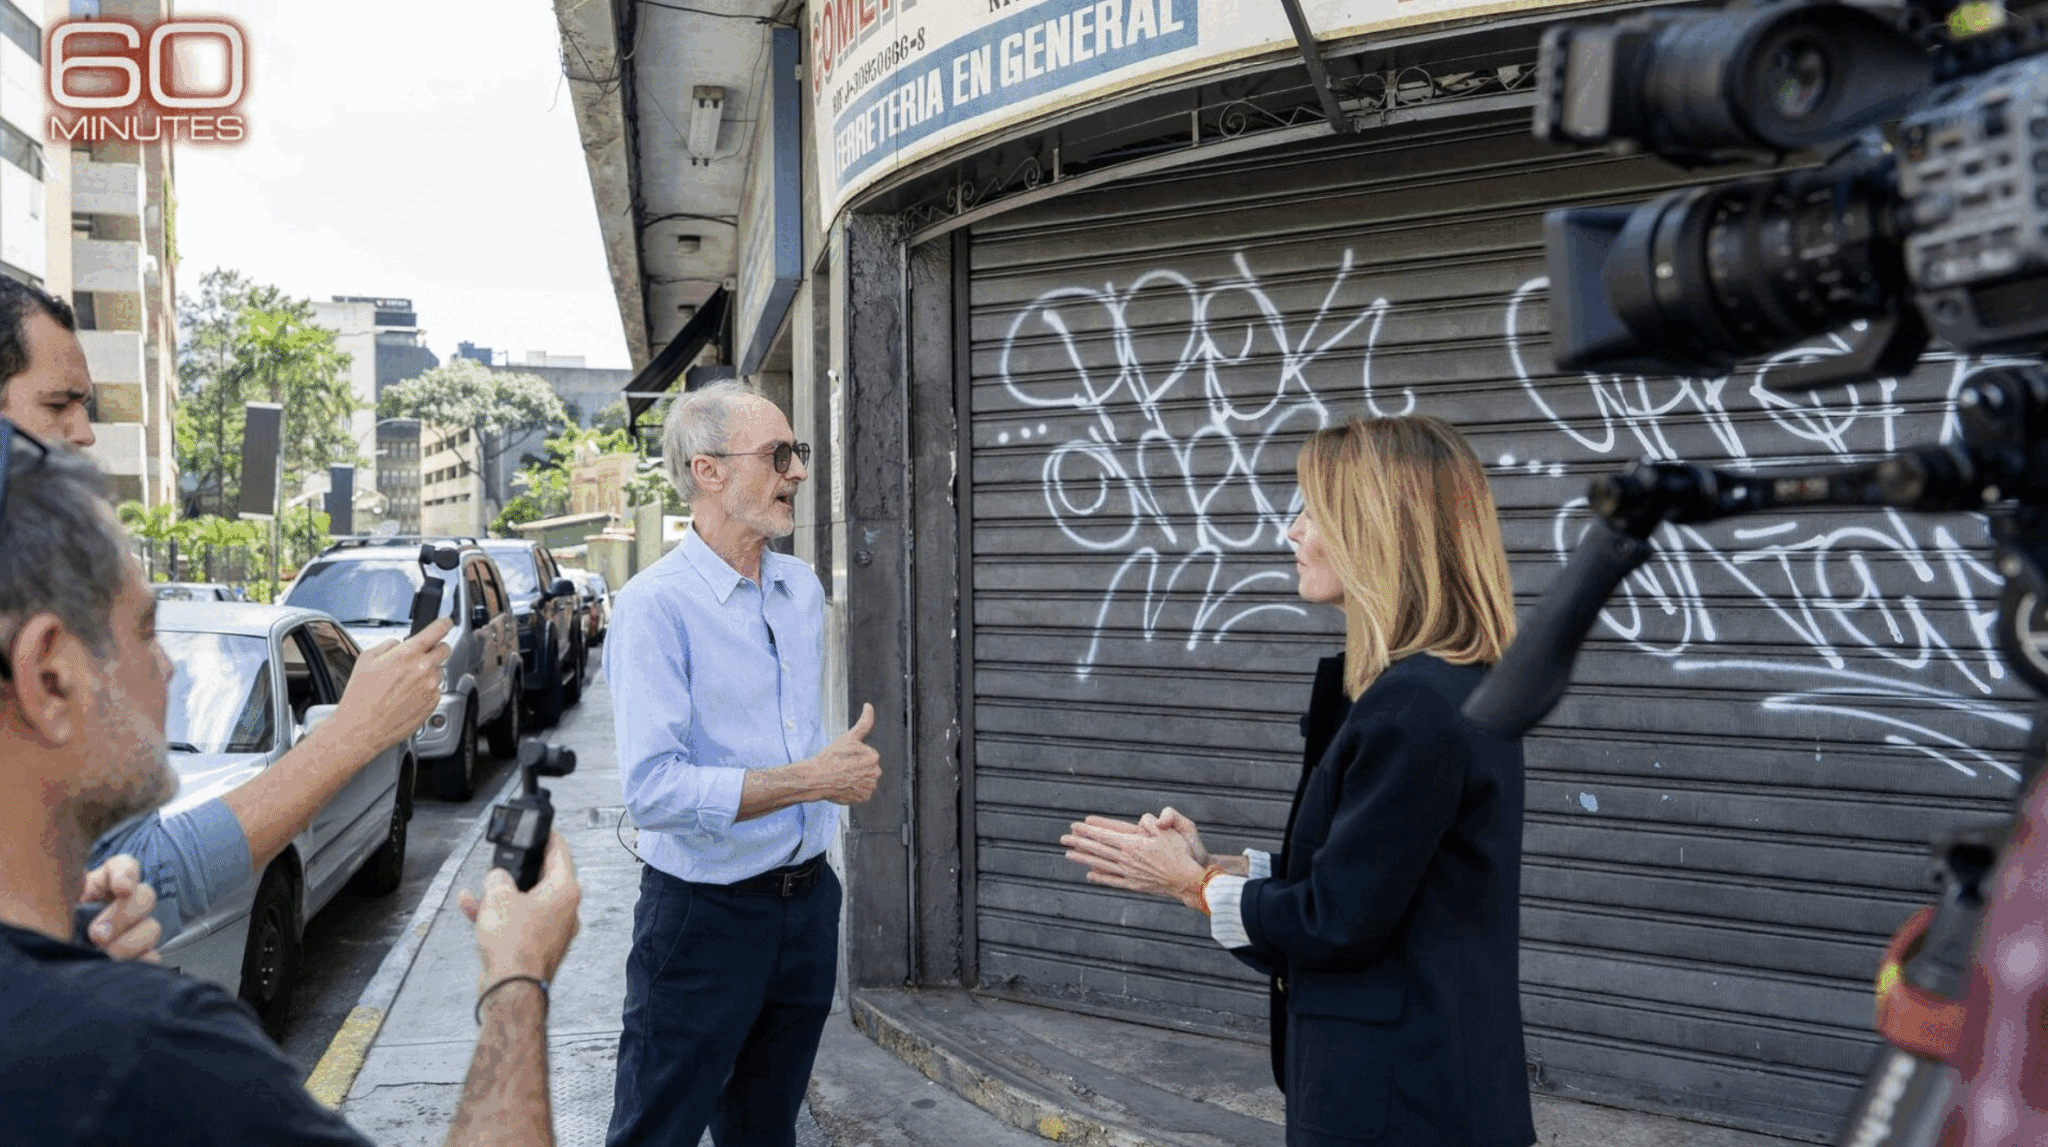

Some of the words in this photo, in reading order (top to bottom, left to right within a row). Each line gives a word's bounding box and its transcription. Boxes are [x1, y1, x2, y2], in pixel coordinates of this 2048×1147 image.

[836, 68, 945, 178] FERRETERIA
[953, 44, 991, 107] EN
[1000, 0, 1184, 88] GENERAL
